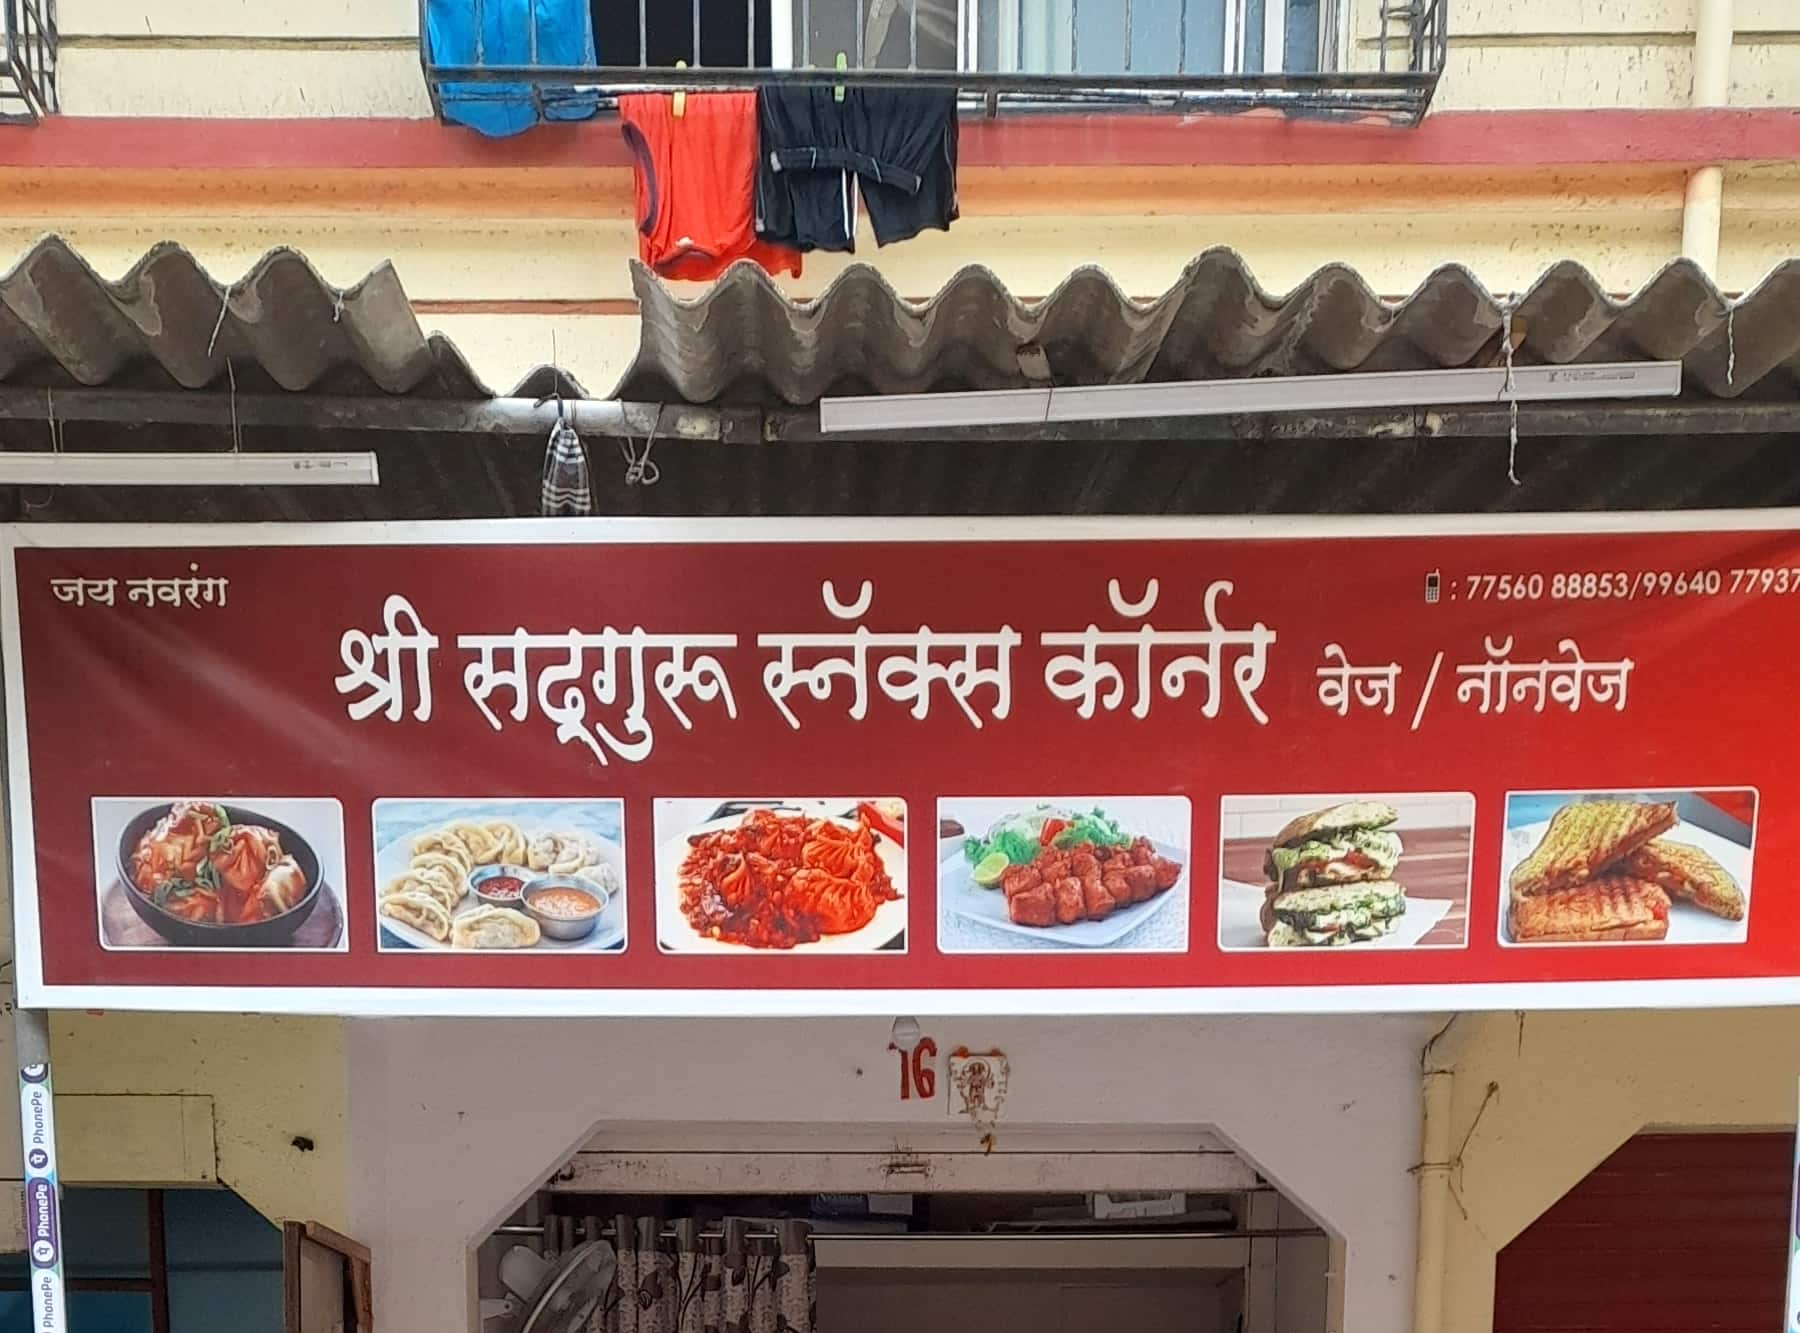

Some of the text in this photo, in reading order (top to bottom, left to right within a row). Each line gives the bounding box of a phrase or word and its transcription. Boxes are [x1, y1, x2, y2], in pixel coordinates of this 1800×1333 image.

[51, 563, 230, 608] जय नवरंग
[1466, 573, 1544, 600] 77560
[1551, 569, 1721, 600] 88853/99640
[334, 594, 439, 722] श्री
[757, 580, 1021, 730] स्नॅक्स
[1041, 578, 1276, 725] कॉर्नर
[1316, 643, 1402, 716] वेज
[1456, 634, 1635, 713] नॉनवेज
[888, 1036, 938, 1101] 16
[31, 1091, 44, 1145] PhonePe
[36, 1184, 50, 1237] PhonePe
[42, 1276, 55, 1328] PhonePe
